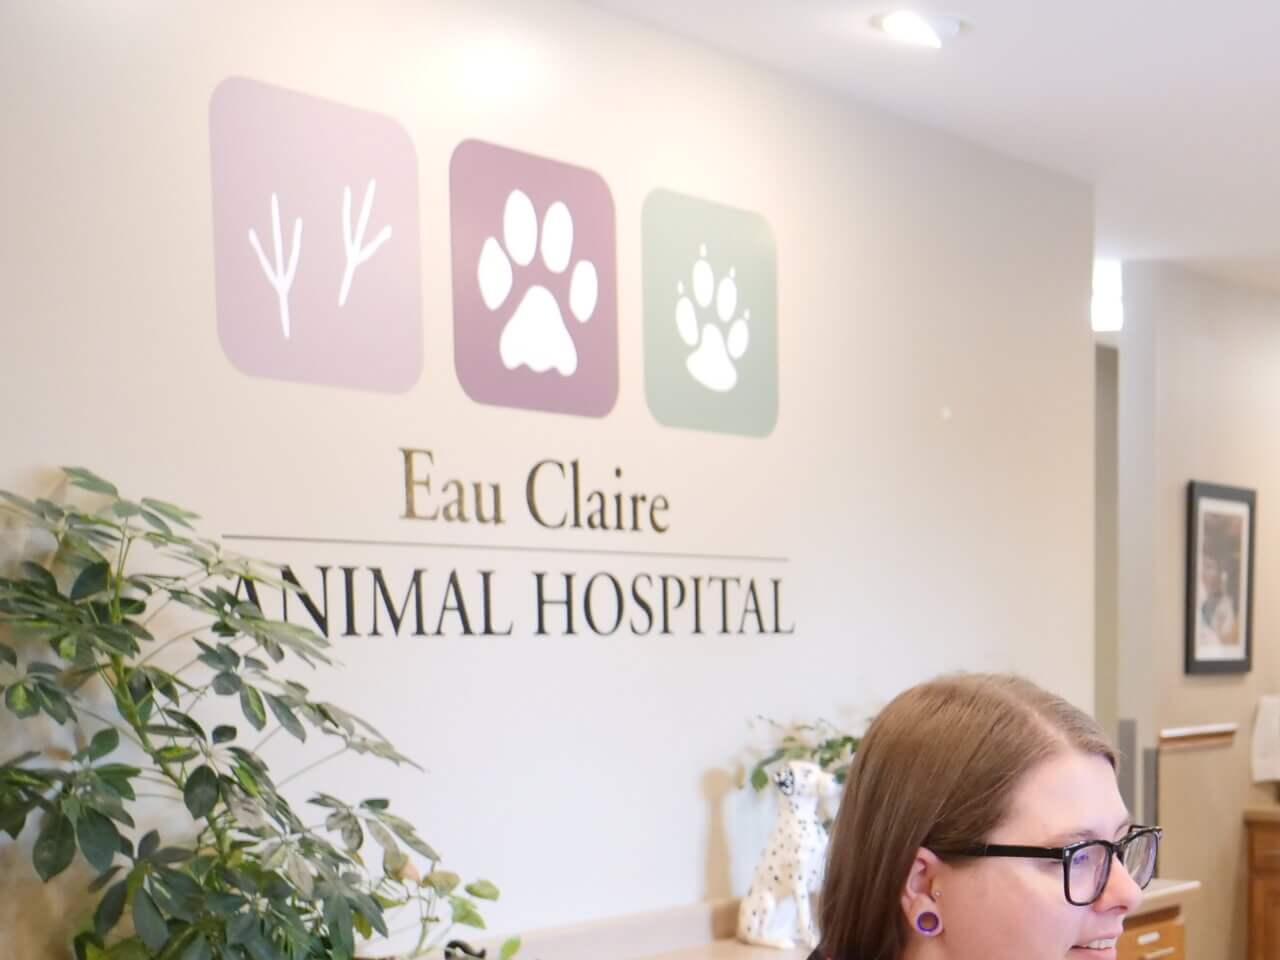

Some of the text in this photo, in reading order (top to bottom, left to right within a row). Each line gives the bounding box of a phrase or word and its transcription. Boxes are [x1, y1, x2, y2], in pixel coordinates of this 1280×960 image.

[399, 447, 671, 534] Eau Claire
[531, 570, 796, 636] HOSPITAL
